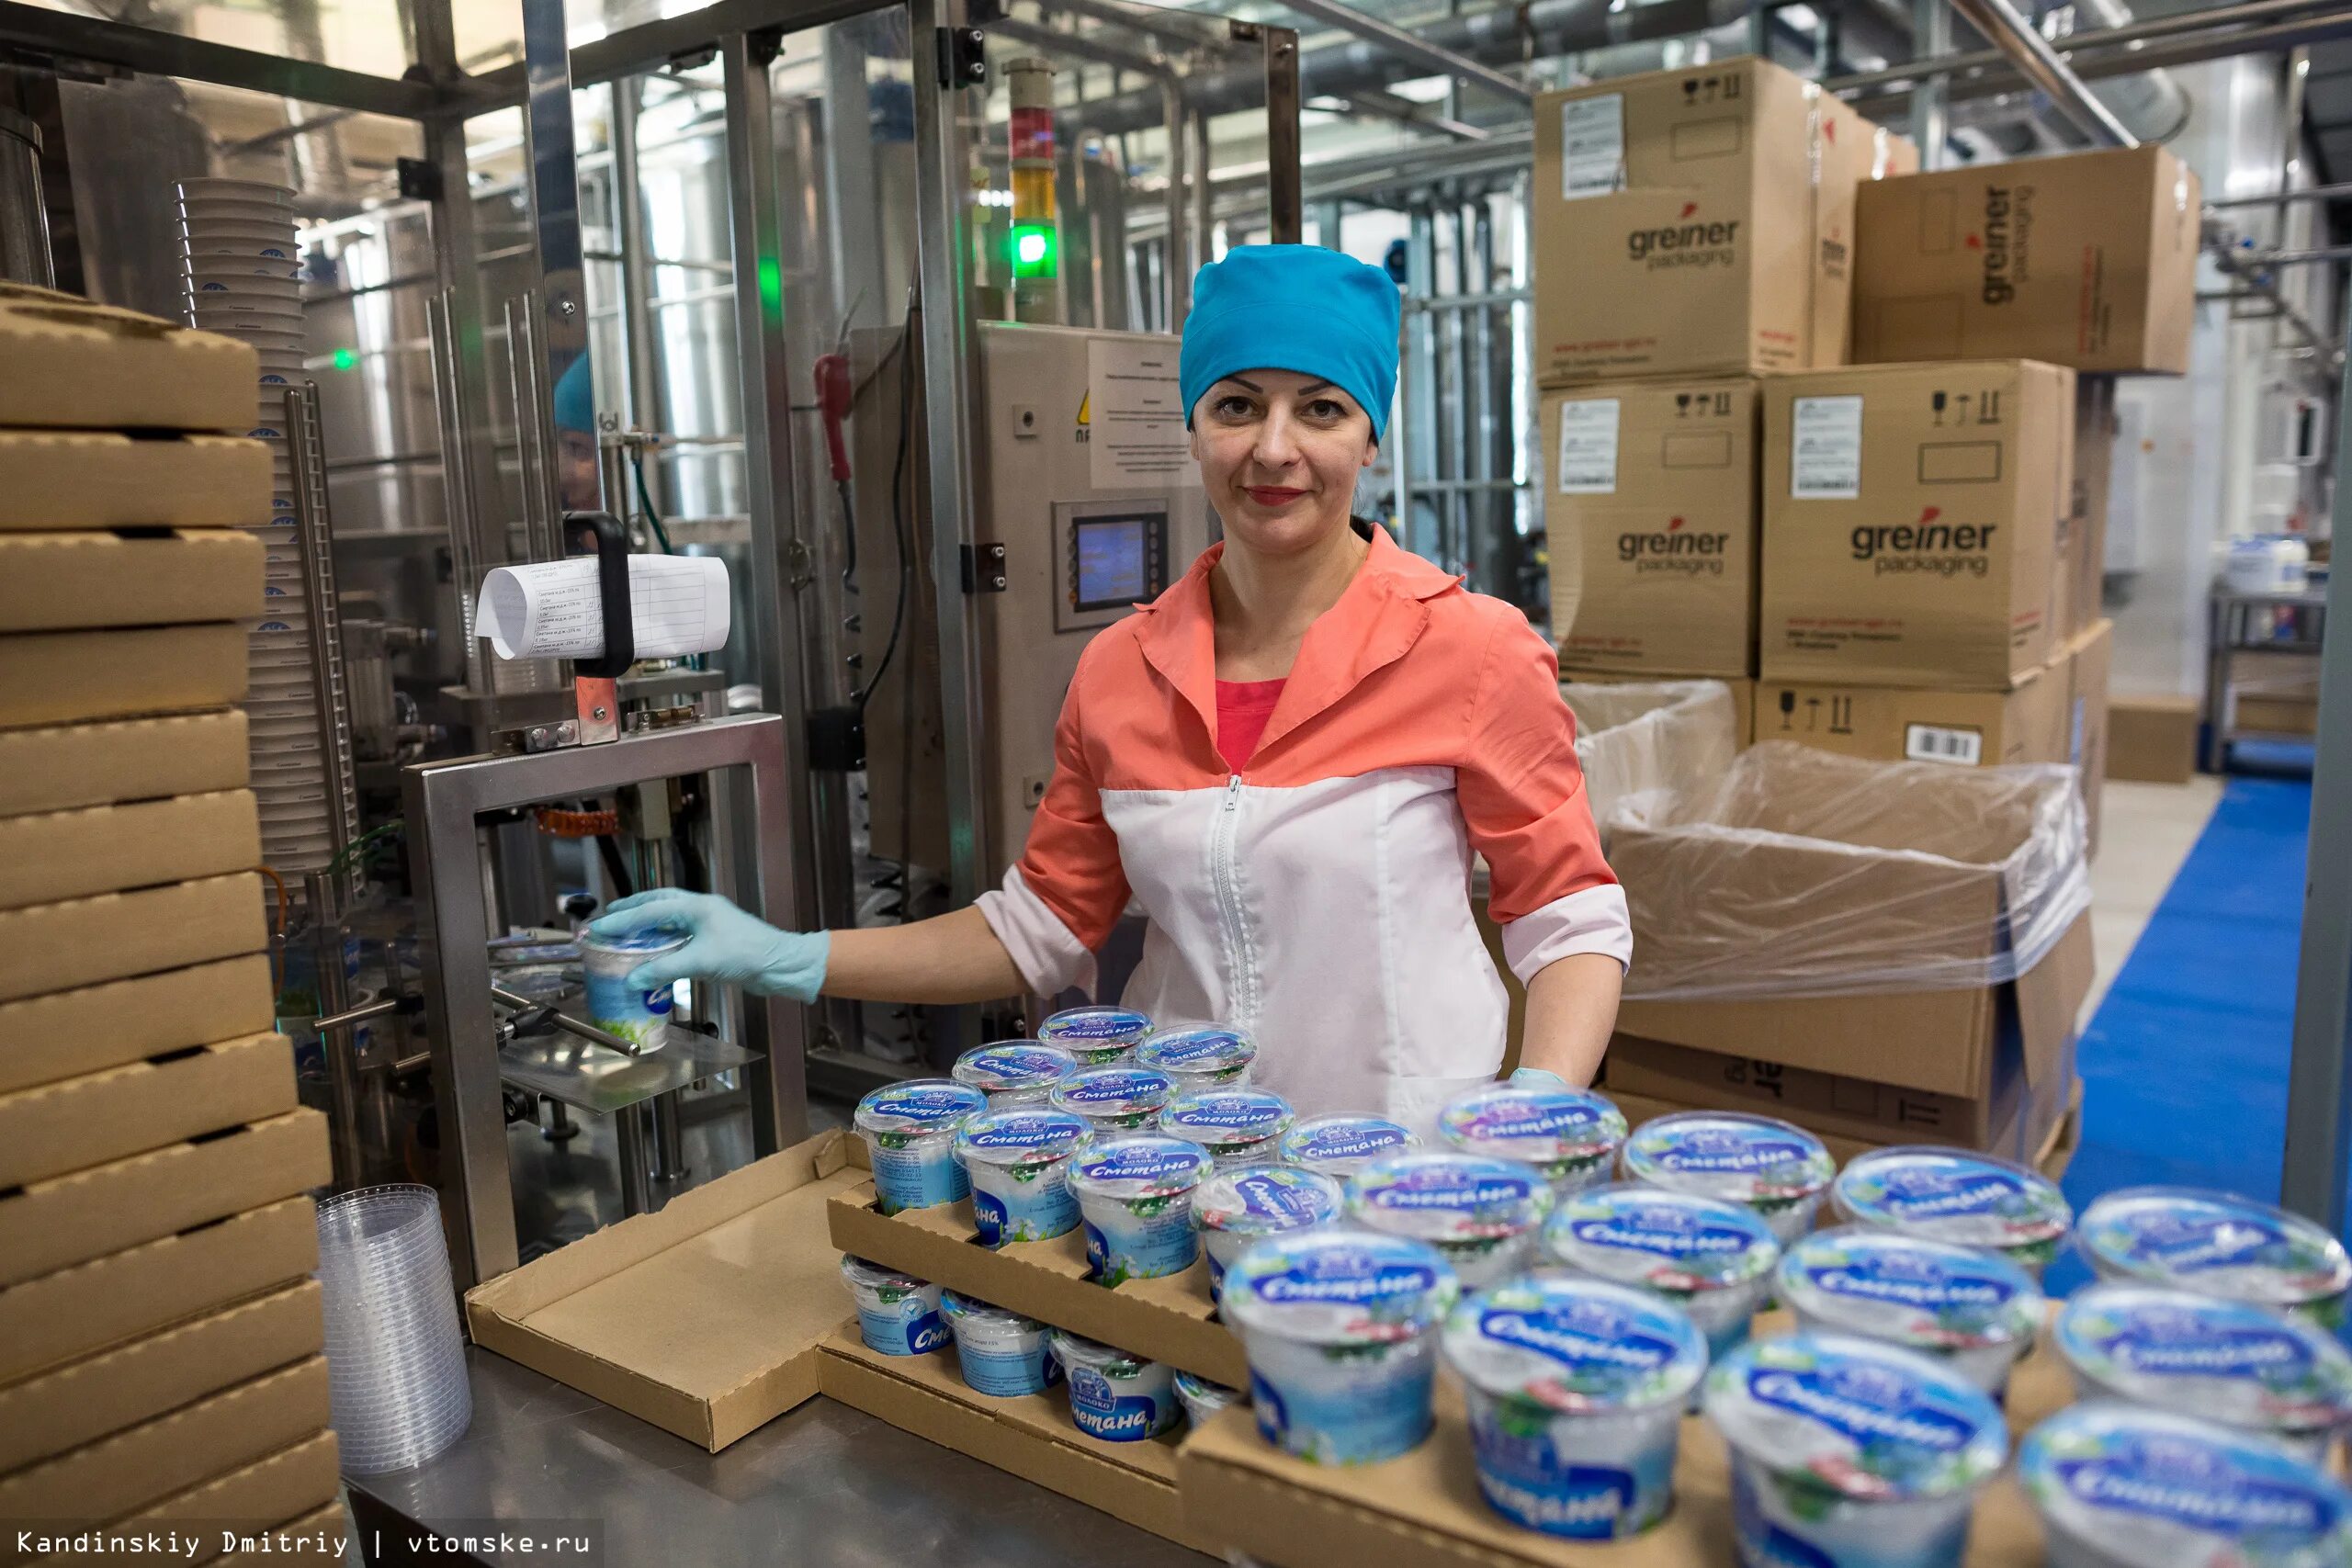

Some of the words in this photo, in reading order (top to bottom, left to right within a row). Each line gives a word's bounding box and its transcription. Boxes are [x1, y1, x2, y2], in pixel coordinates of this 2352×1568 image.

[1628, 201, 1740, 261] greiner
[1965, 184, 2015, 306] greiner
[1618, 516, 1730, 561] greiner
[1850, 506, 1999, 560] greiner
[1873, 555, 1989, 579] packaging
[1057, 1025, 1137, 1037] Сметана
[1072, 1083, 1159, 1100] Сметана
[1181, 1112, 1276, 1124] Сметана
[977, 1129, 1073, 1145] Сметана
[1305, 1134, 1396, 1157] Сметана
[1090, 1159, 1192, 1177] Сметана
[1076, 1393, 1110, 1411] МОЛОКО
